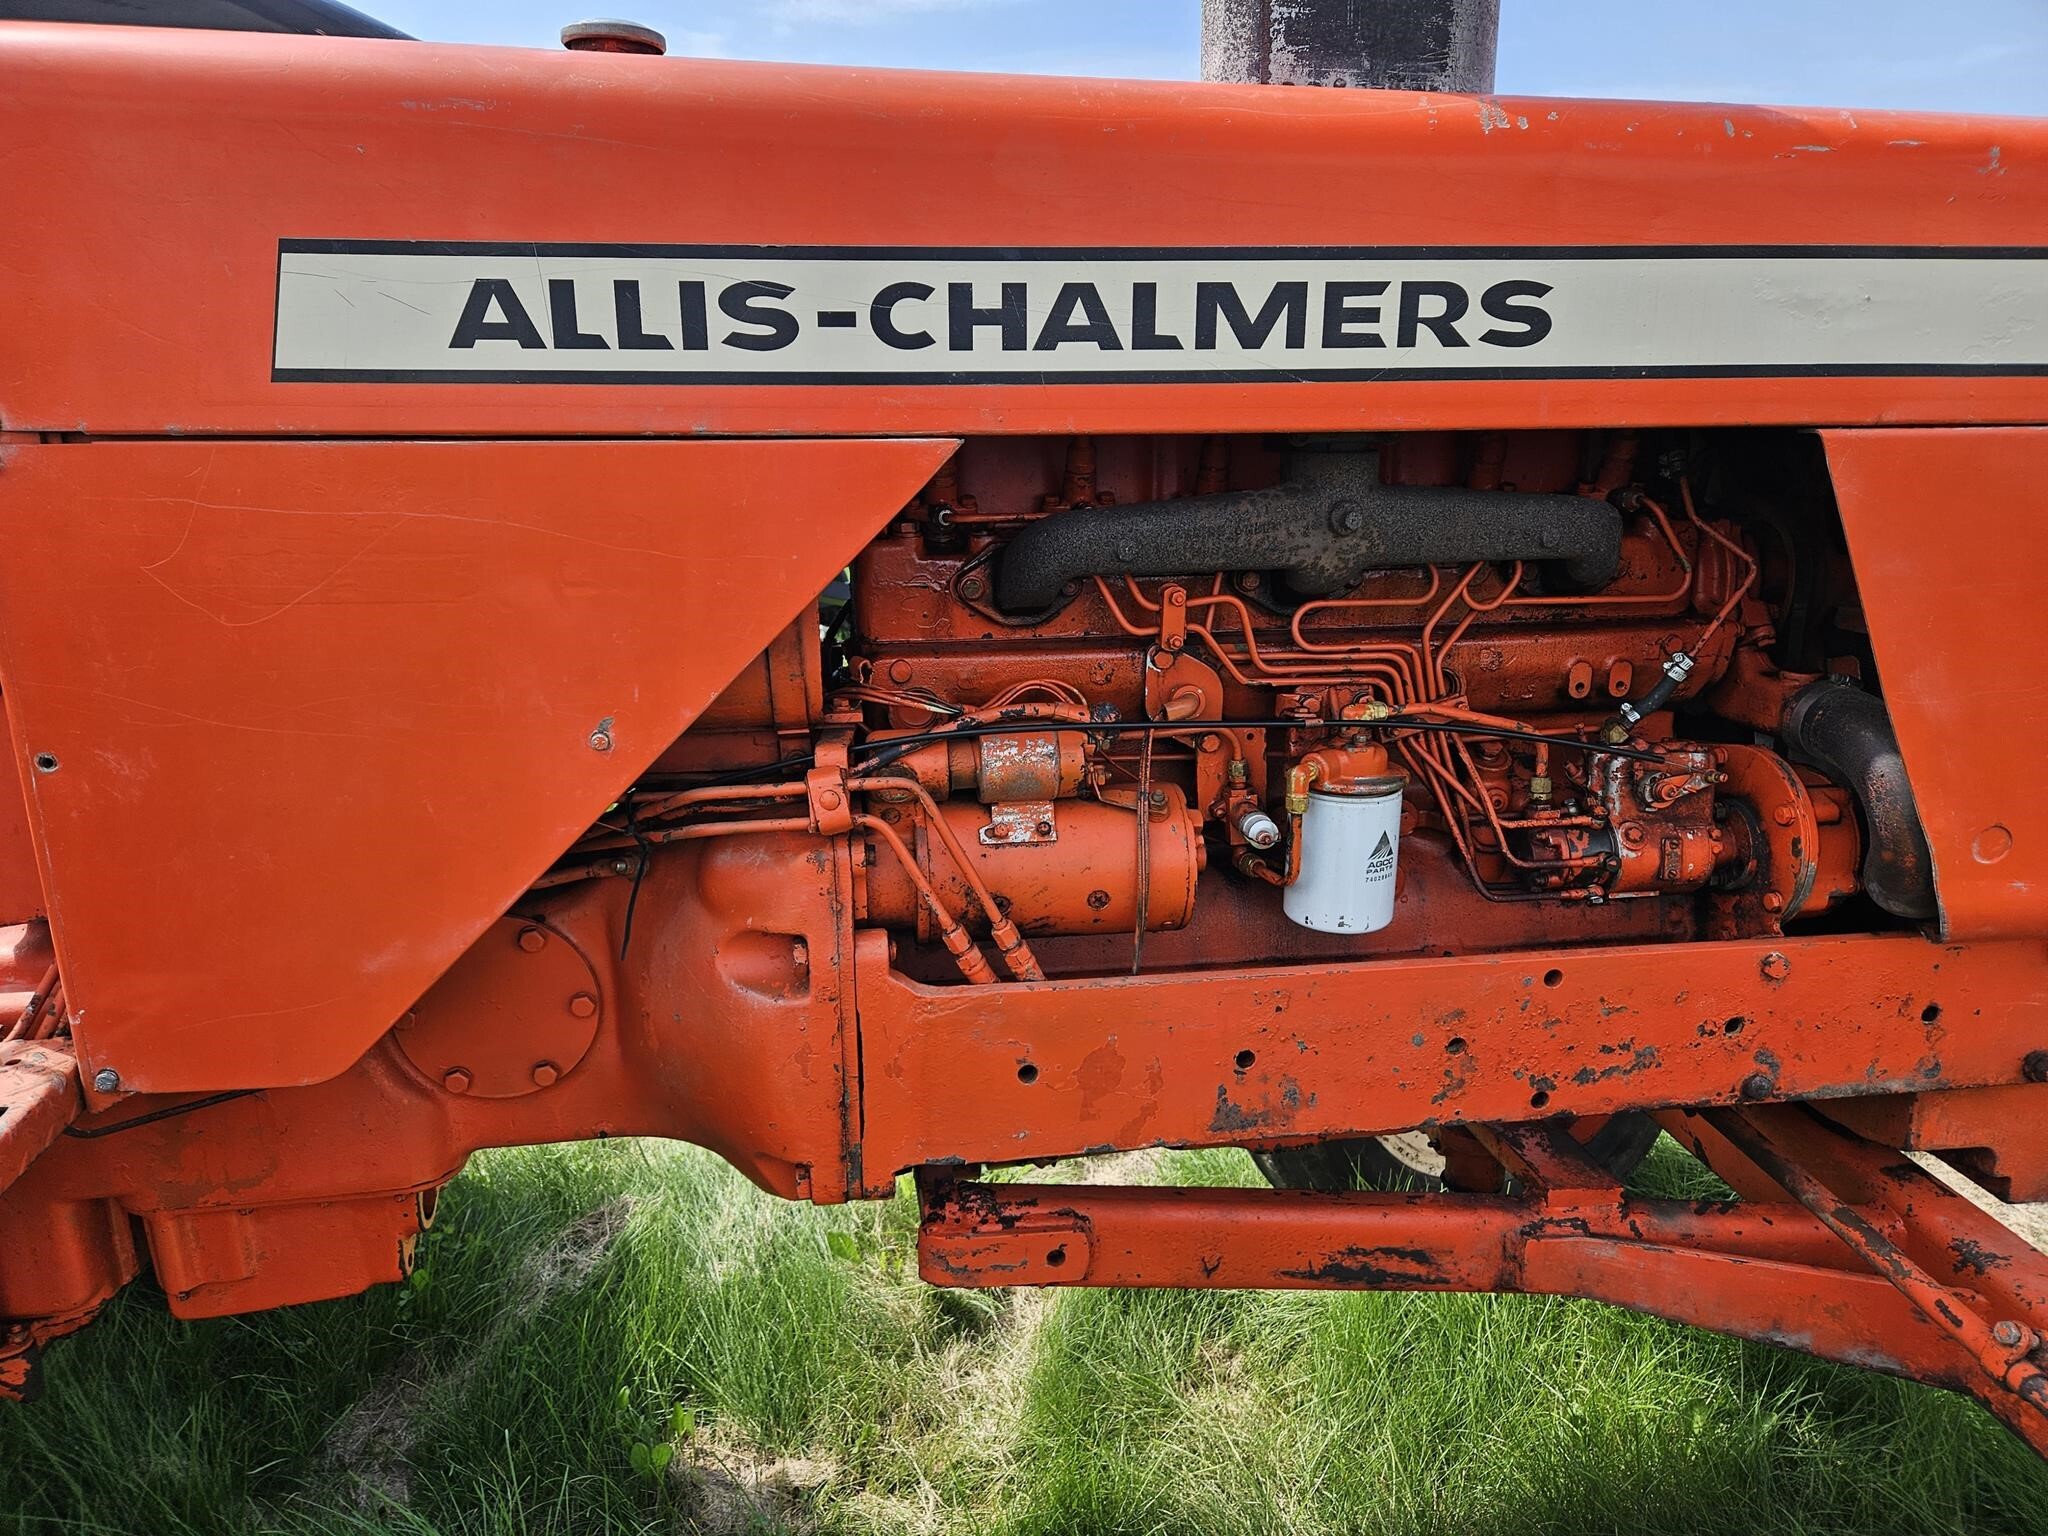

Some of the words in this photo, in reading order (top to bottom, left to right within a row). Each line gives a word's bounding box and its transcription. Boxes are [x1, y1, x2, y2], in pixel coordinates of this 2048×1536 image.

[447, 278, 1554, 352] ALLIS-CHALMERS
[1367, 857, 1394, 869] AGCO
[1366, 864, 1393, 875] PARTS
